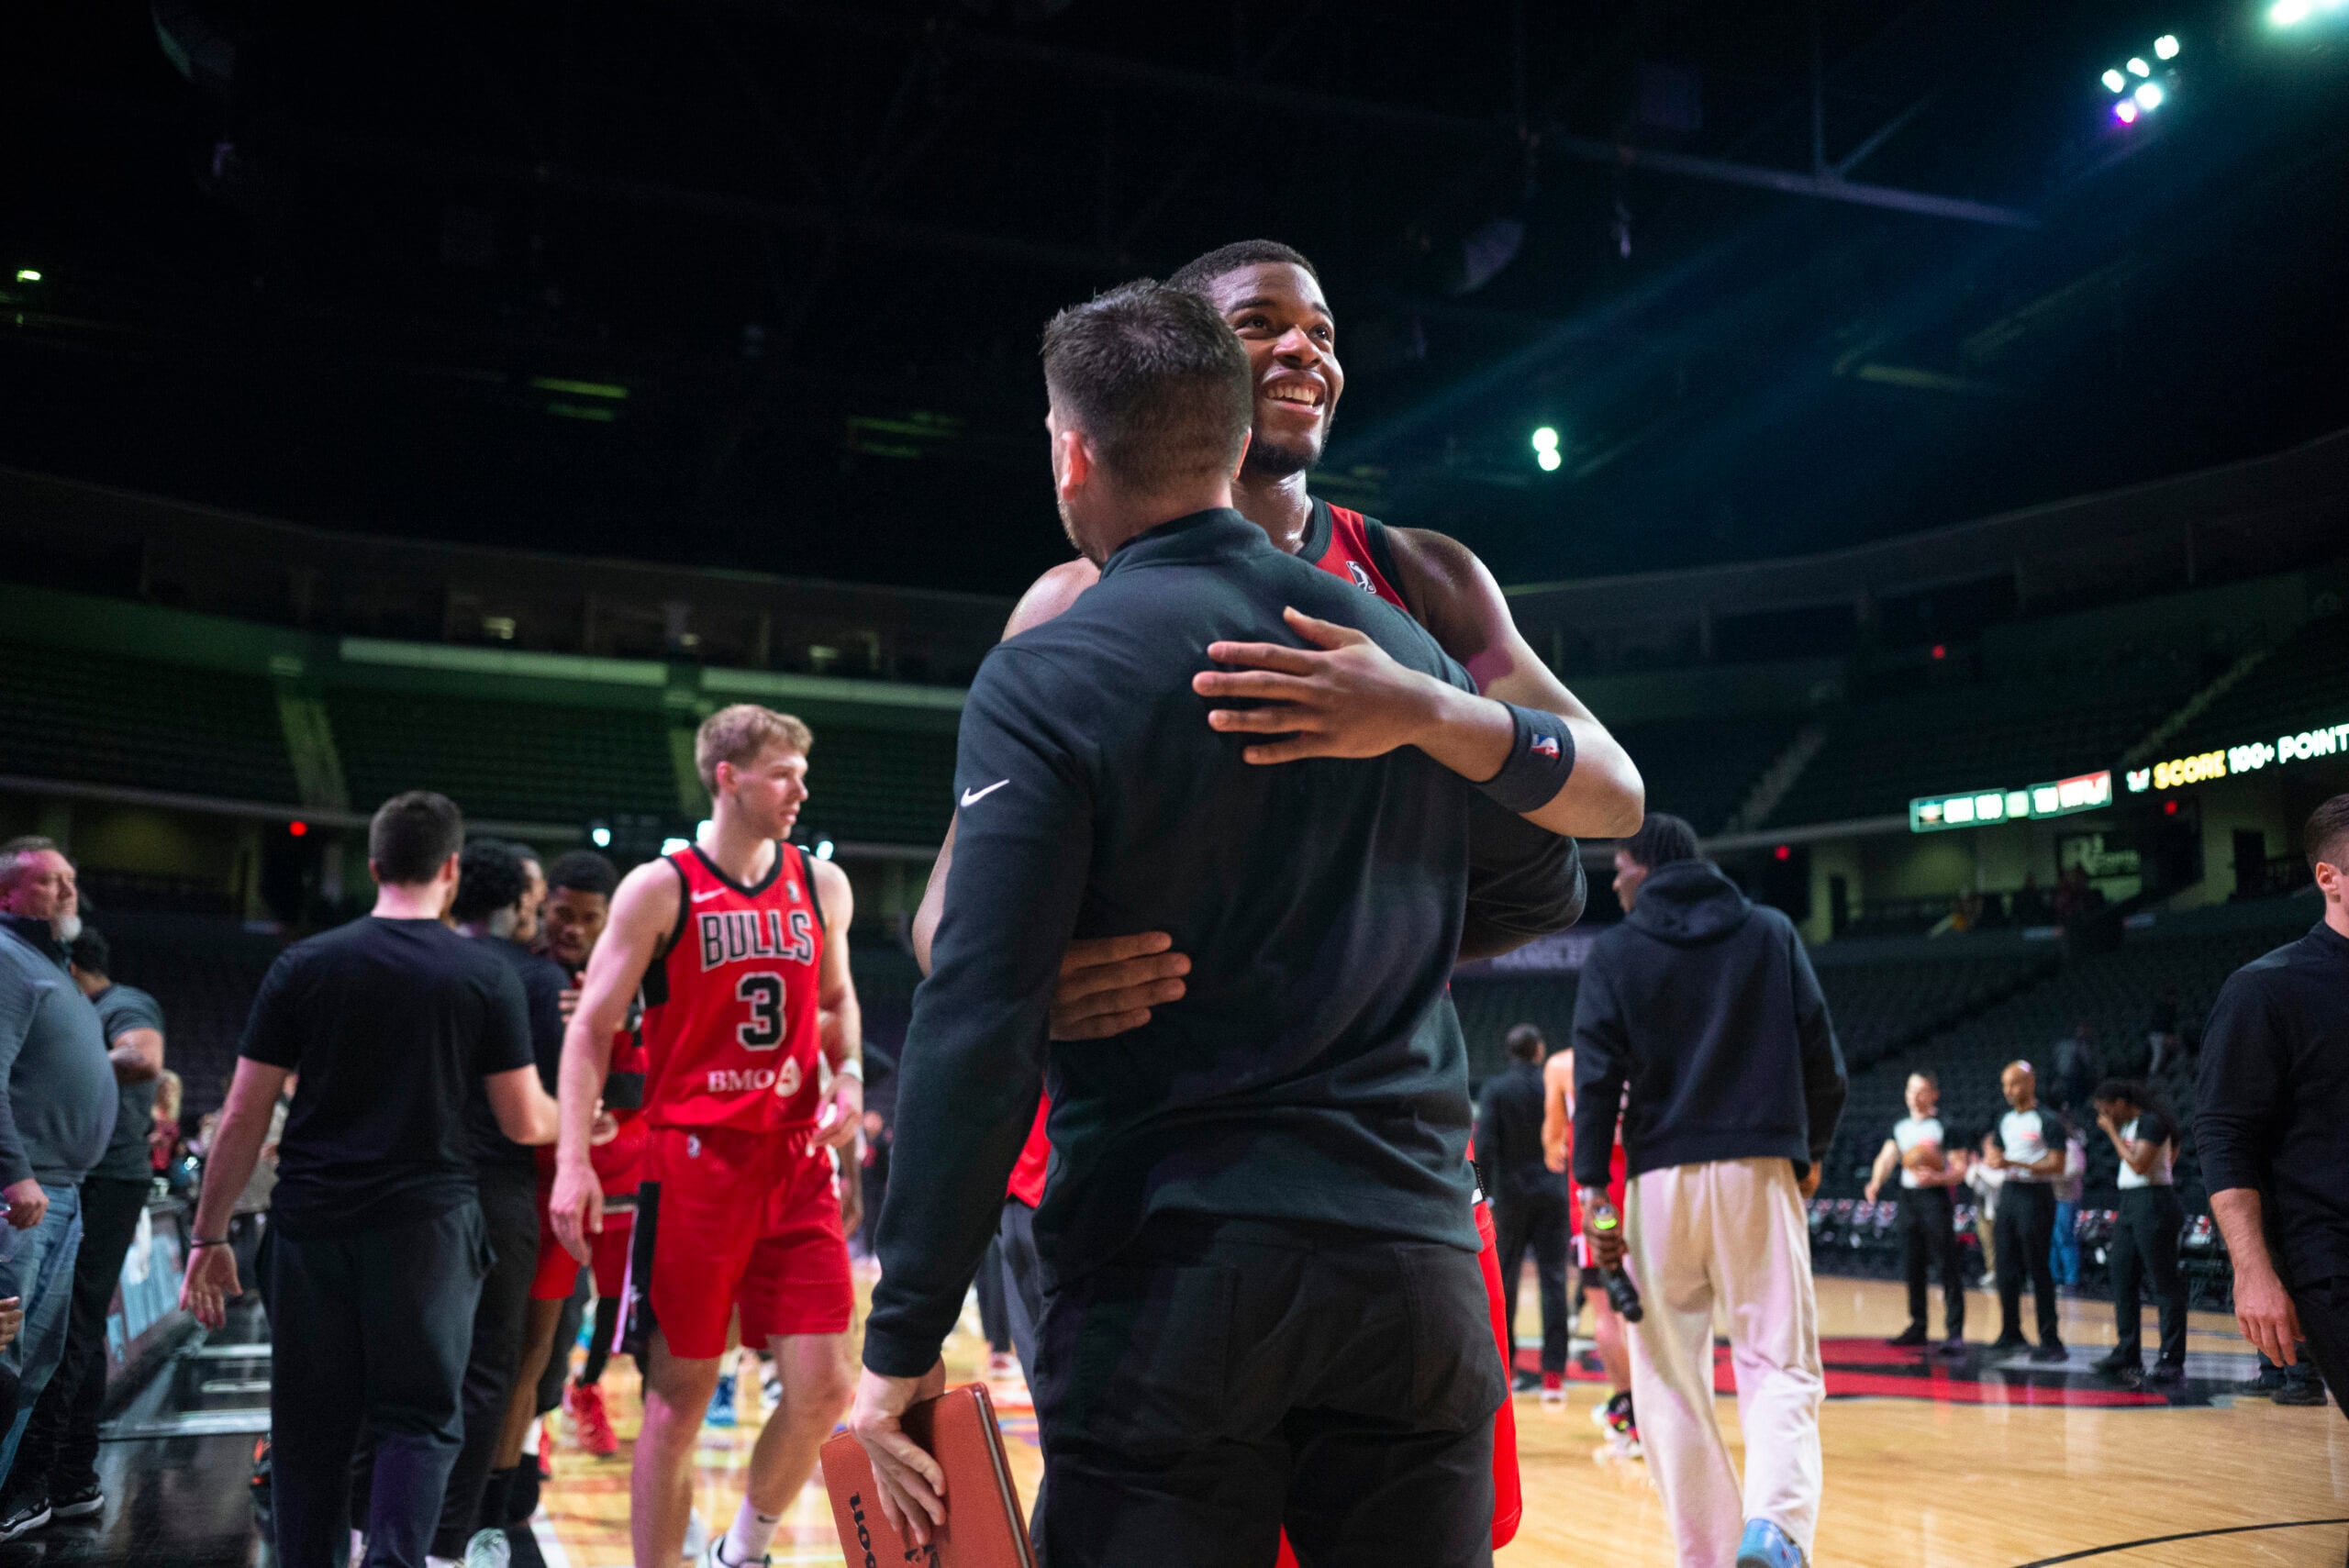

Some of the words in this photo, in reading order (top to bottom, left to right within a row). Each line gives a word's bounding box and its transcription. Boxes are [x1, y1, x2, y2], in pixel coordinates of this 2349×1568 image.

[2153, 750, 2227, 790] SCORE
[696, 909, 815, 973] BULLS
[736, 971, 786, 1051] 3
[707, 1069, 775, 1093] BMO
